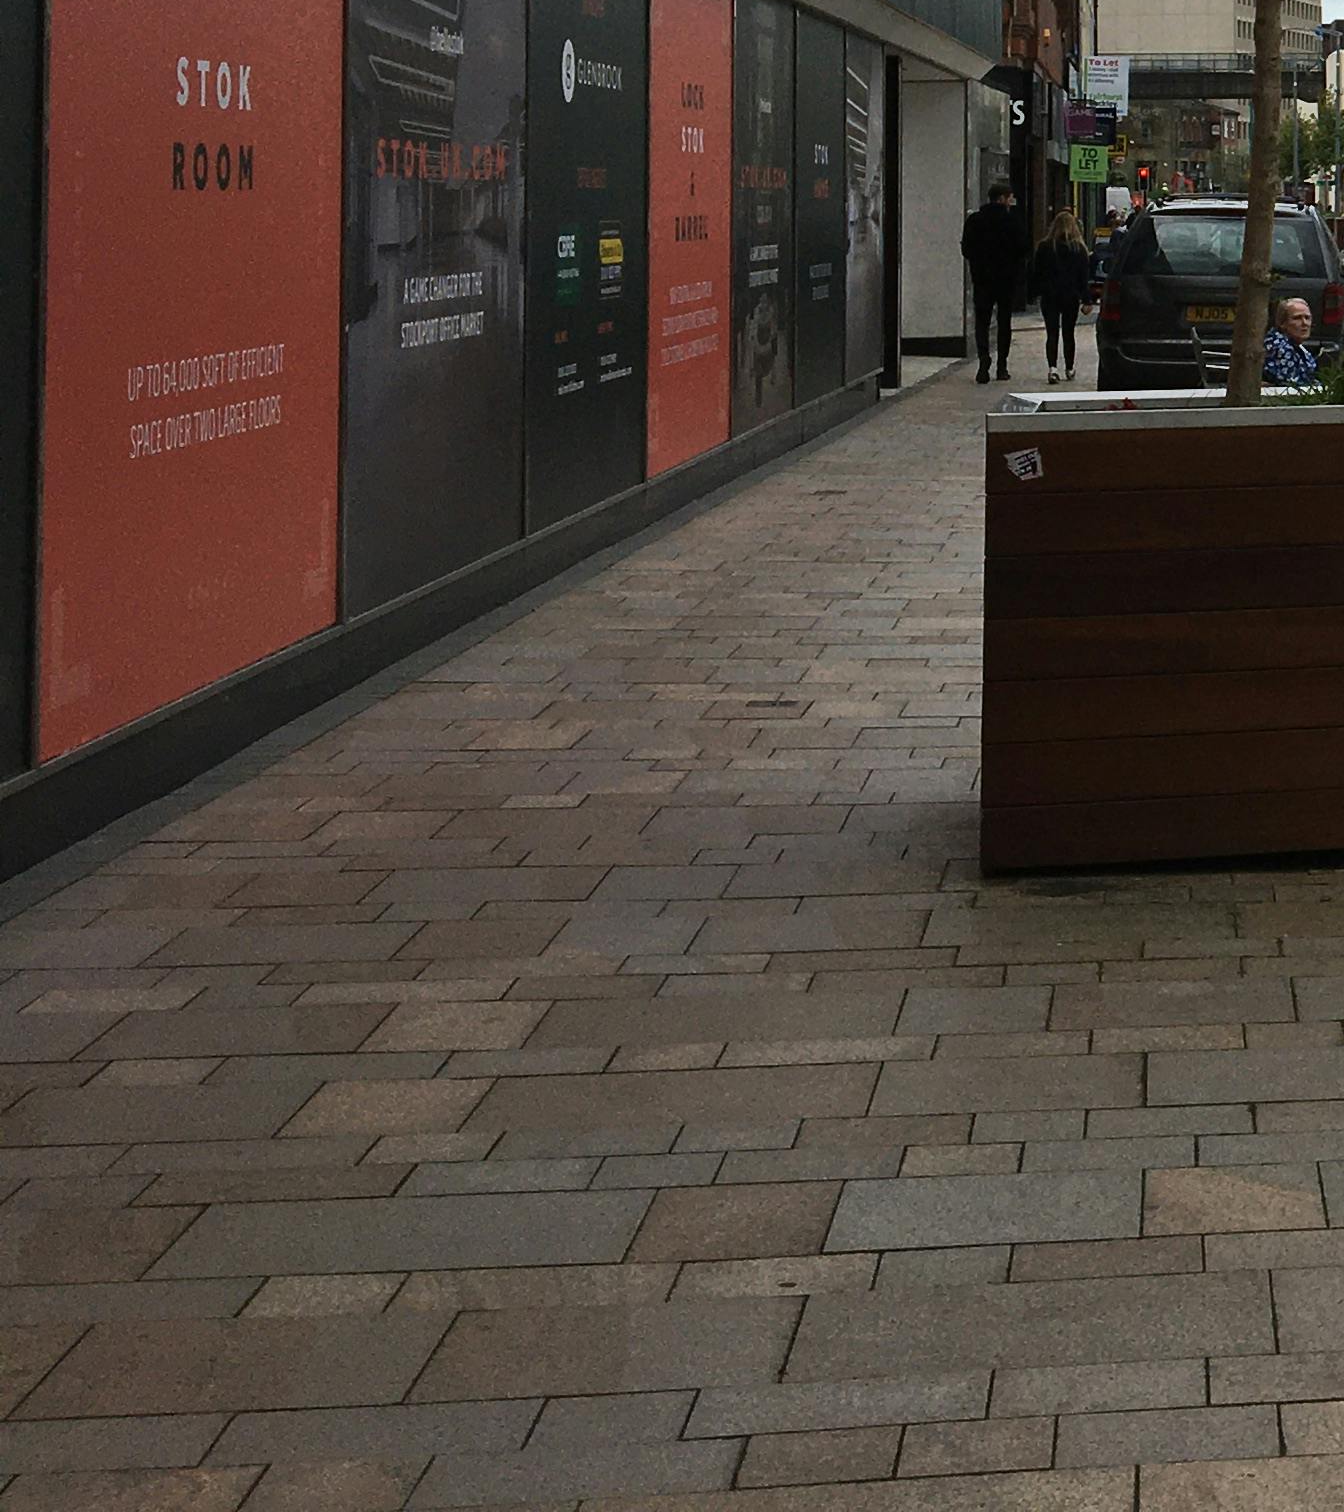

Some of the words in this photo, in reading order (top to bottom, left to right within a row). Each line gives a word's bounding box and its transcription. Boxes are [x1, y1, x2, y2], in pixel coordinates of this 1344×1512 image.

[577, 57, 623, 92] GLENBROOK
[1088, 58, 1101, 67] To
[1103, 58, 1119, 67] Let
[176, 55, 253, 112] STOK
[680, 81, 705, 110] LOCK
[680, 125, 705, 154] STOK
[1081, 146, 1098, 158] TO
[172, 141, 254, 191] ROOM
[1078, 159, 1099, 170] LET
[403, 278, 409, 305] A
[409, 276, 429, 304] GAME
[429, 273, 459, 302] CHANGER
[459, 272, 471, 297] FOR
[471, 271, 483, 295] THE
[401, 317, 440, 349] STOCKPORT
[439, 314, 460, 342] OFFICE
[461, 310, 485, 338] MARKET
[127, 366, 144, 402] UP
[146, 363, 161, 398] TO
[163, 356, 200, 398] 64,000
[227, 350, 240, 382] OF
[241, 343, 285, 380] EFFICIENT
[128, 419, 162, 459] SPACE
[165, 413, 192, 451] OVER
[193, 408, 216, 441] TWO
[217, 401, 248, 438] LARGE
[249, 394, 282, 430] FLOORS
